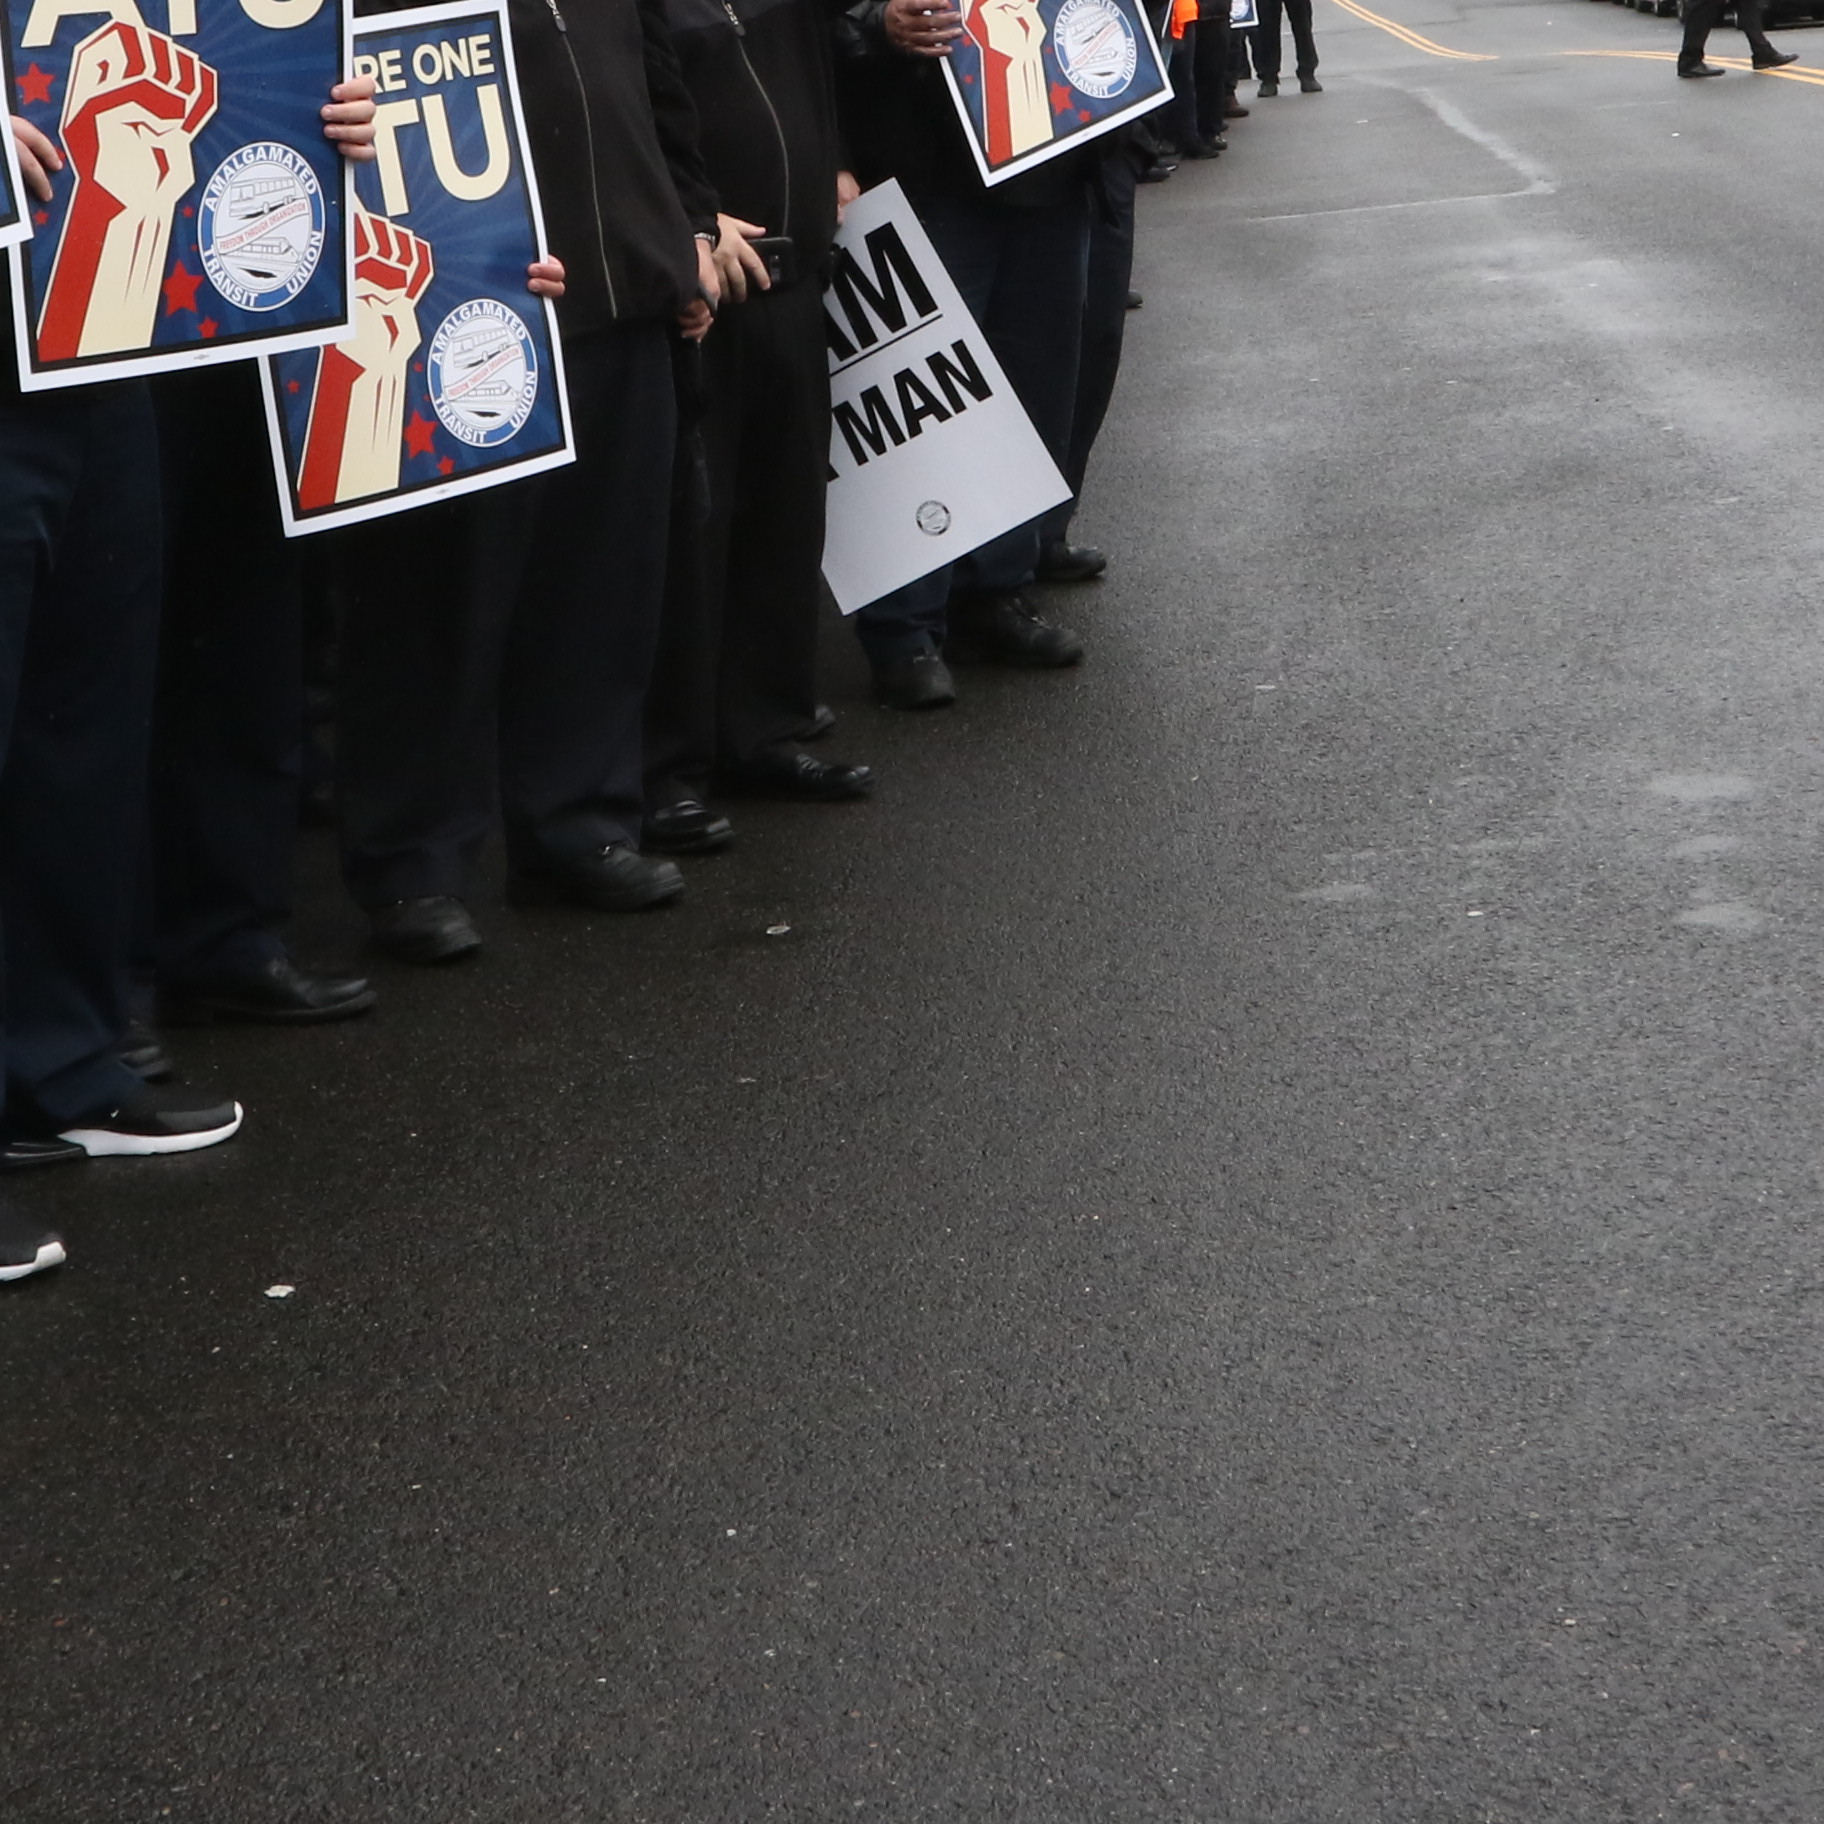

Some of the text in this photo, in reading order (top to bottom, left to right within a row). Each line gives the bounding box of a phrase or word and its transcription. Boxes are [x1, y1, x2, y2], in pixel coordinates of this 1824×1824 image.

[412, 34, 495, 85] ONE
[1066, 67, 1108, 96] TRANSIT
[1122, 37, 1136, 81] UNION
[205, 144, 317, 212] AMALGAMATED
[203, 244, 258, 307] TRANSIT
[286, 230, 322, 294] UNION
[431, 302, 526, 366] AMALGAMATED
[435, 394, 487, 444] TRANSIT
[509, 370, 536, 429] UNION
[832, 339, 994, 466] MAN
